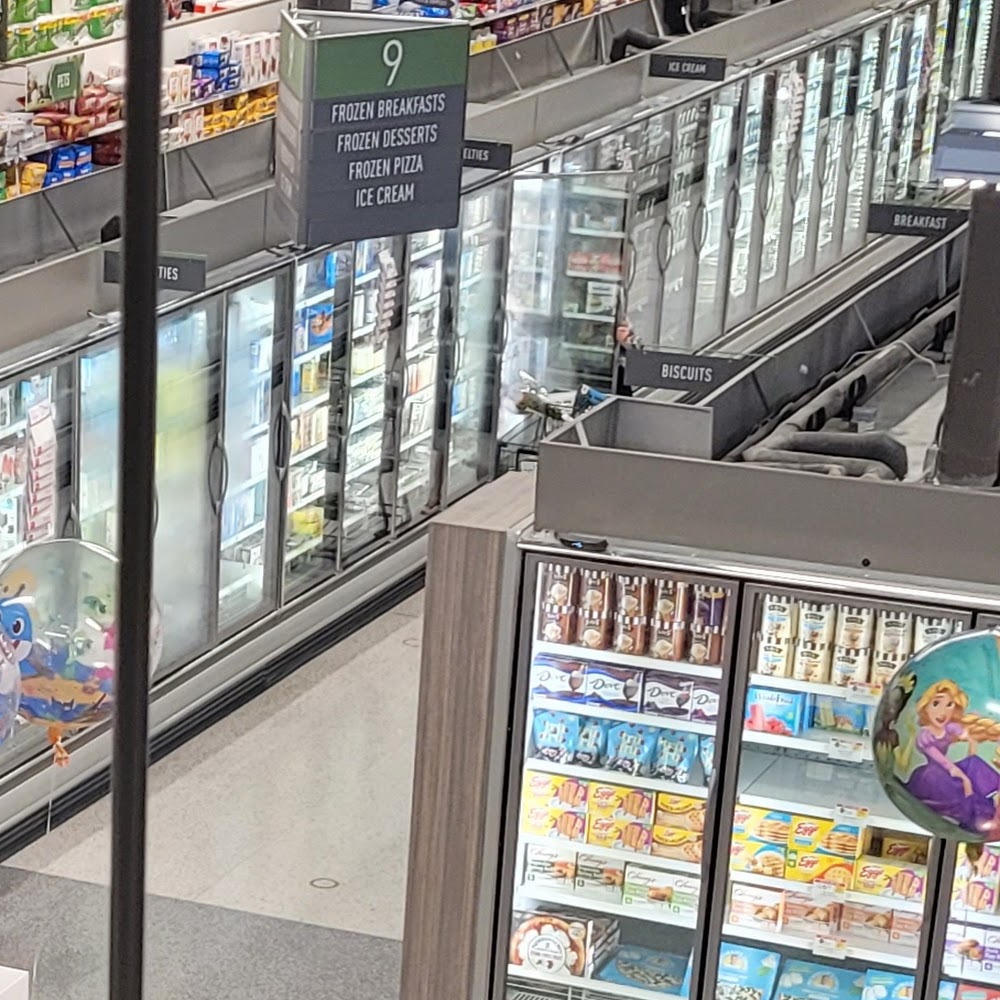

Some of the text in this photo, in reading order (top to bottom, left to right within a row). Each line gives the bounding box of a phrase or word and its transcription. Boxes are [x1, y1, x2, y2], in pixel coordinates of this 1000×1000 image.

[383, 39, 403, 87] 9
[57, 72, 71, 88] PETS
[331, 93, 446, 124] FROZEN BREAKFASTS
[337, 124, 438, 153] FROZEN DESSERTS
[463, 147, 489, 161] ELTIES
[349, 154, 423, 180] FROZEN PIZZA
[356, 183, 415, 207] ICE CREAM
[893, 213, 947, 230] BREAKFAST
[159, 266, 179, 281] TIES
[661, 363, 713, 383] BISCUITS
